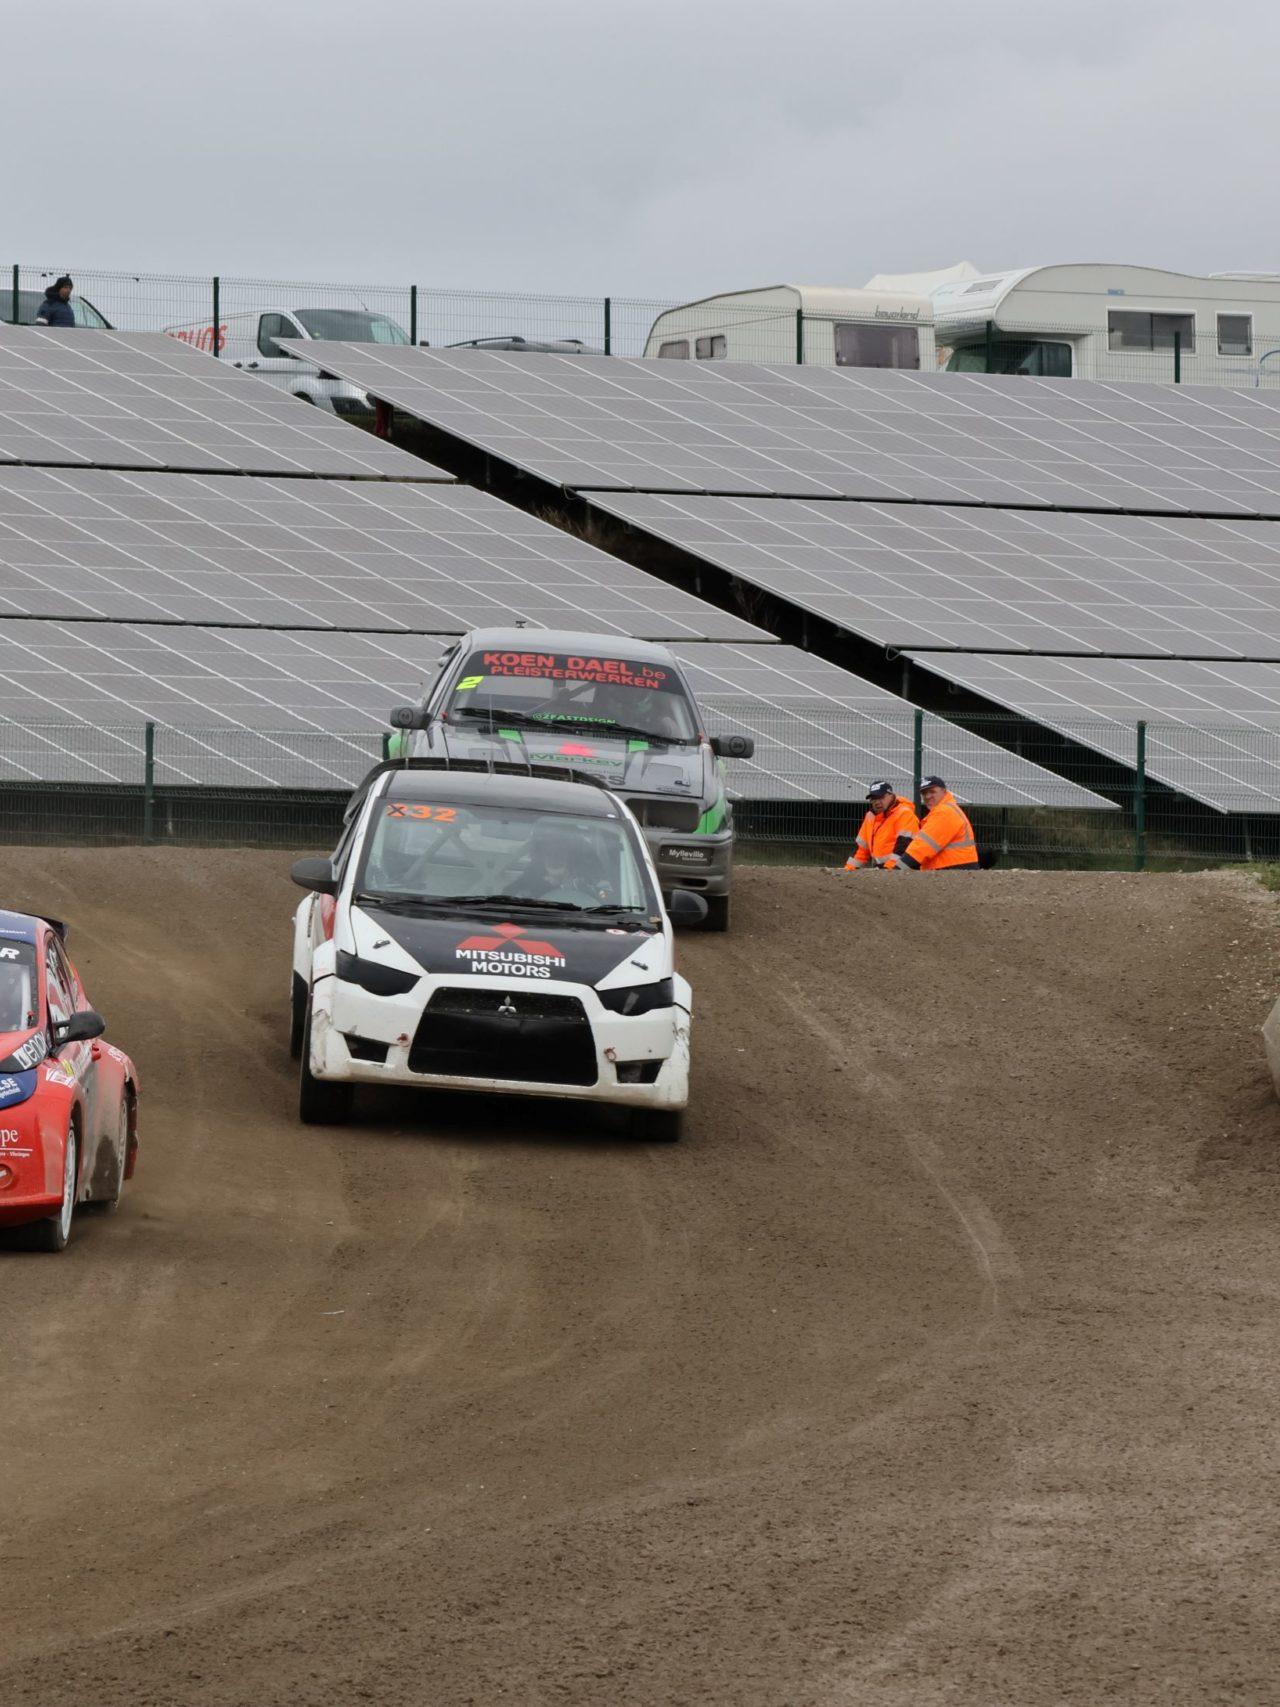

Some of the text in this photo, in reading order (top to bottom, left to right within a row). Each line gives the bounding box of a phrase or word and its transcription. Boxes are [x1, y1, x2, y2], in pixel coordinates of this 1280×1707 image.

[483, 652, 555, 668] KOEN
[566, 656, 634, 676] DAEL
[456, 675, 484, 691] 2
[490, 665, 660, 689] PLEISTERWERKEN
[455, 949, 566, 968] MITSUBISHI
[471, 961, 551, 979] MOTORS
